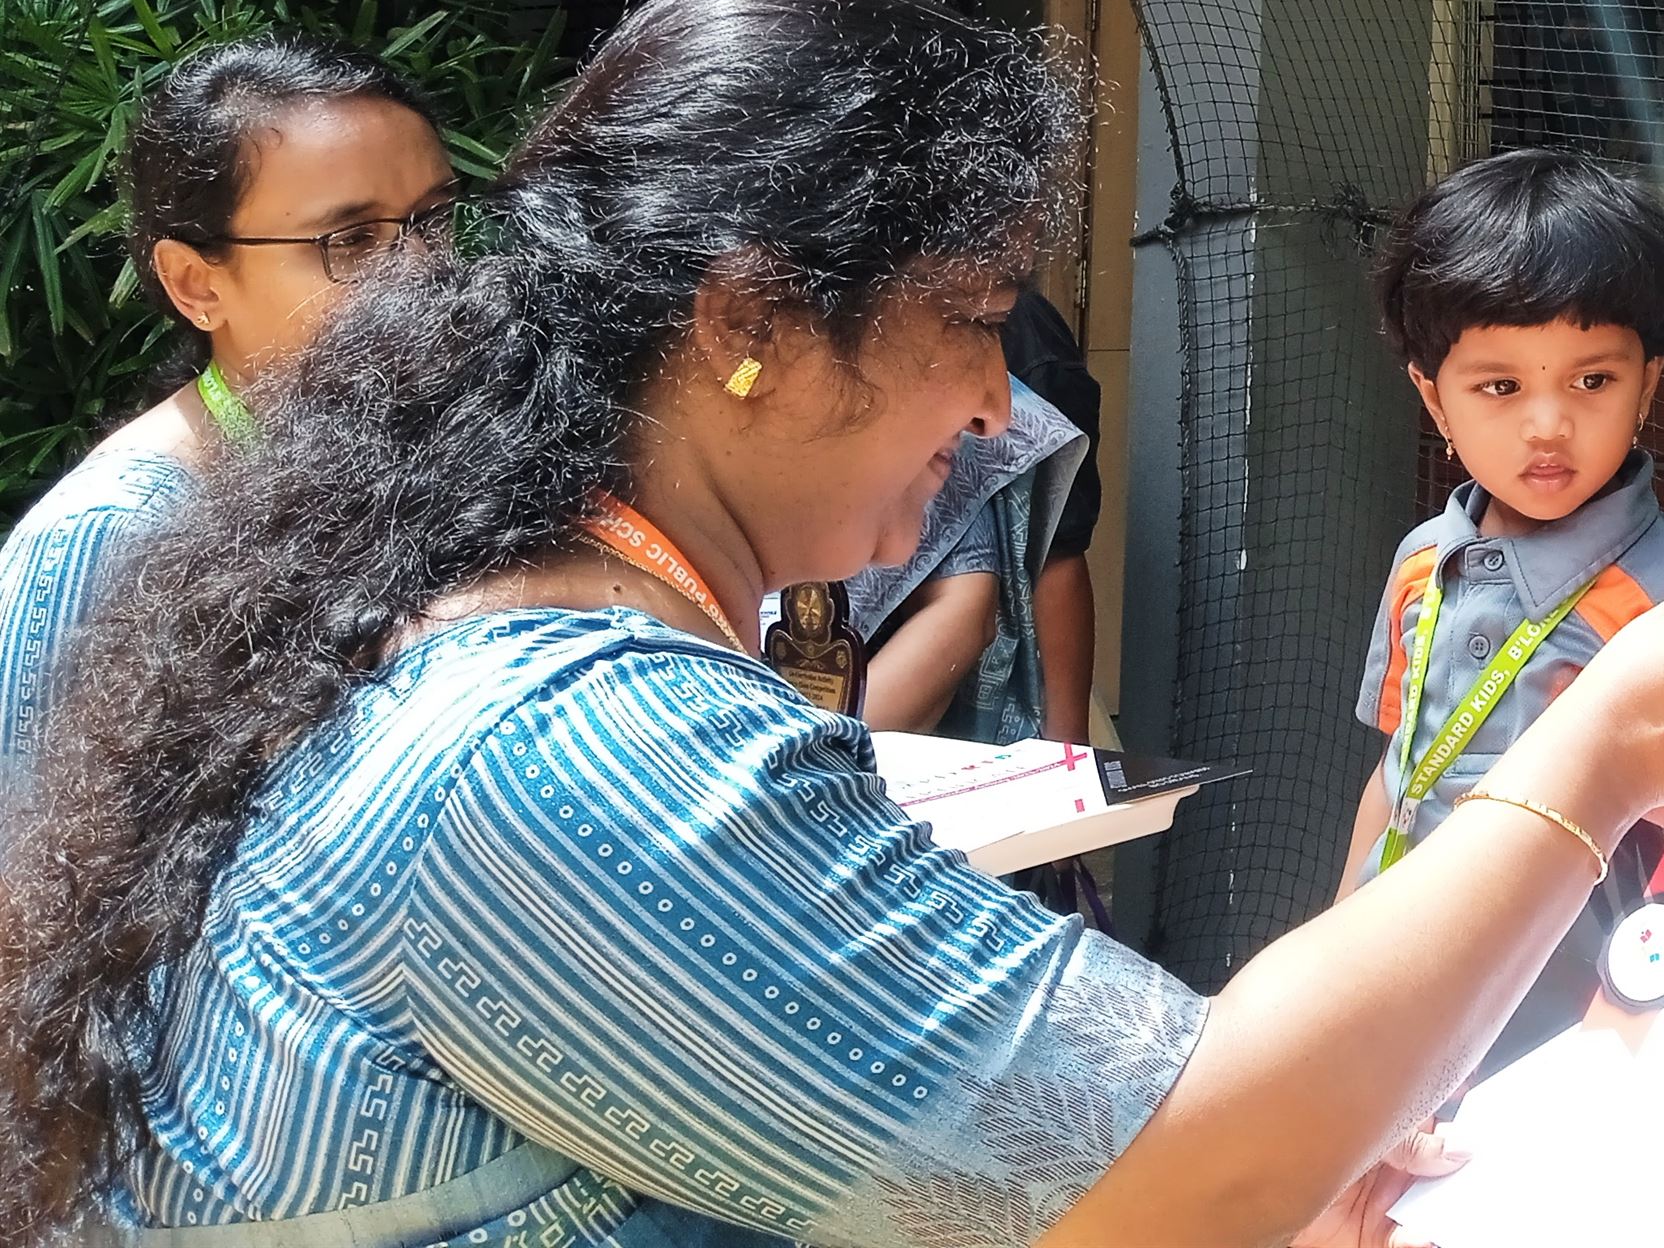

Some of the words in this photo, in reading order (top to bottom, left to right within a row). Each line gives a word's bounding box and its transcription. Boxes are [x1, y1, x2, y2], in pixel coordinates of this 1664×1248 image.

[645, 543, 707, 606] PUBLIC
[1412, 710, 1475, 795] STANDARD
[1469, 668, 1512, 713] KIDS,
